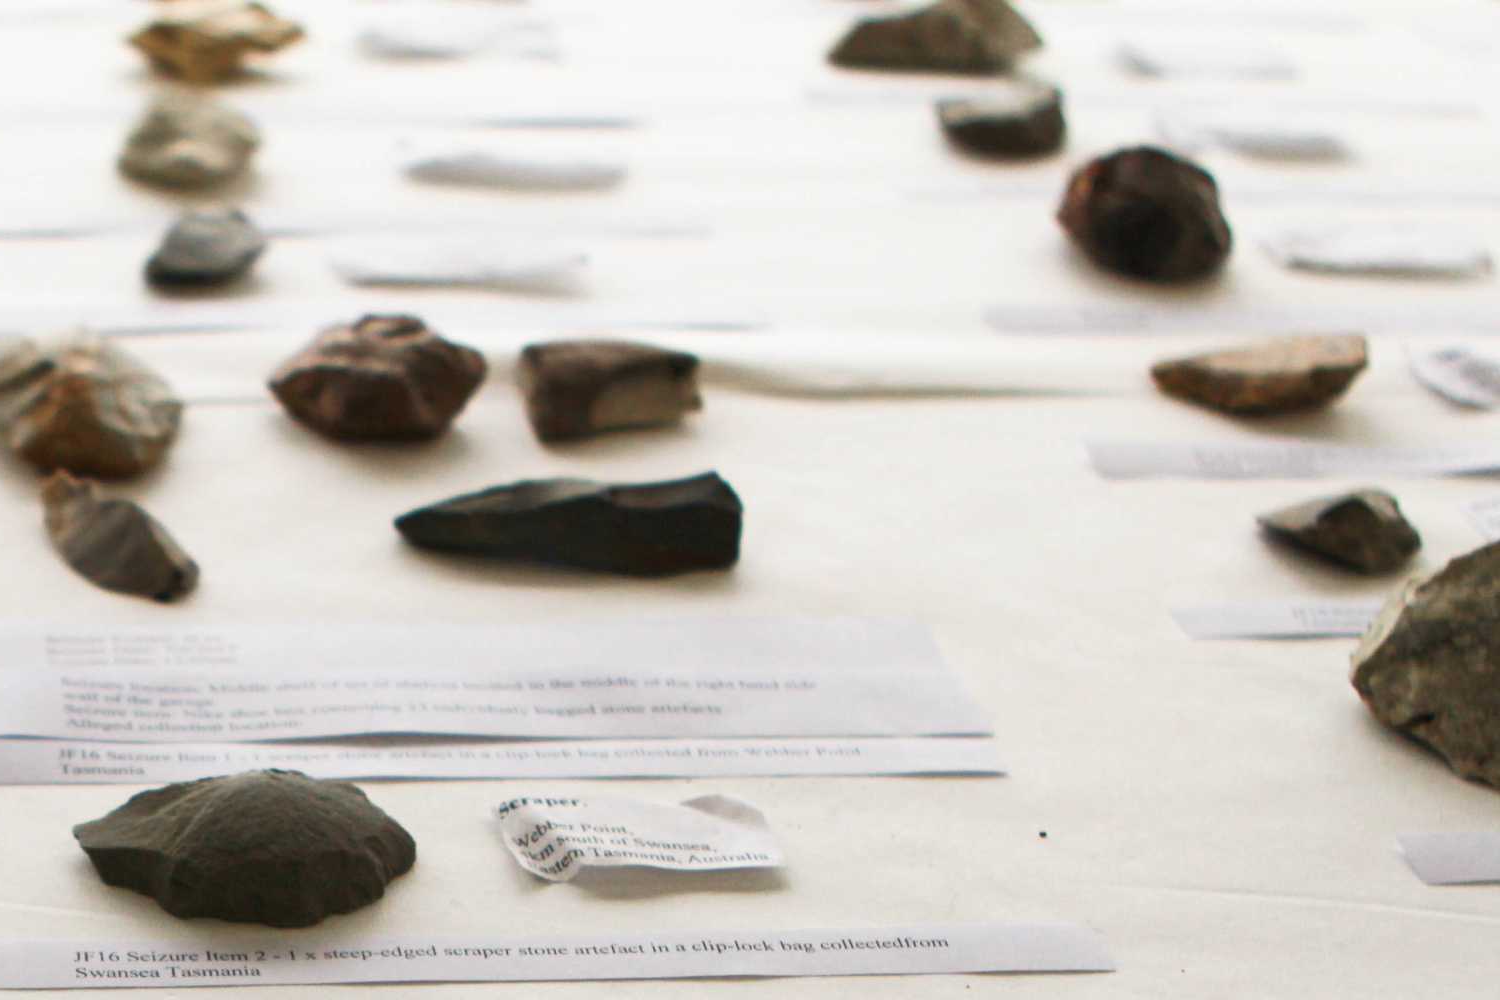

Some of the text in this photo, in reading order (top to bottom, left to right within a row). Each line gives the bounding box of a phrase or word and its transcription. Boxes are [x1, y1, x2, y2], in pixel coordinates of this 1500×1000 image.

[513, 821, 573, 848] Webber
[610, 836, 628, 846] of
[534, 848, 584, 874] astern
[75, 950, 120, 962] JF16
[127, 950, 199, 961] Seizure
[205, 949, 249, 961] Item
[323, 945, 437, 961] steep-edged
[444, 946, 511, 959] scraper
[519, 943, 567, 955] stone
[574, 942, 644, 955] artefact
[650, 941, 669, 952] in
[692, 940, 774, 954] clip-lock
[780, 939, 816, 953] bag
[821, 937, 949, 951] collectedfrom
[76, 964, 261, 979] Swansea Tasmania
